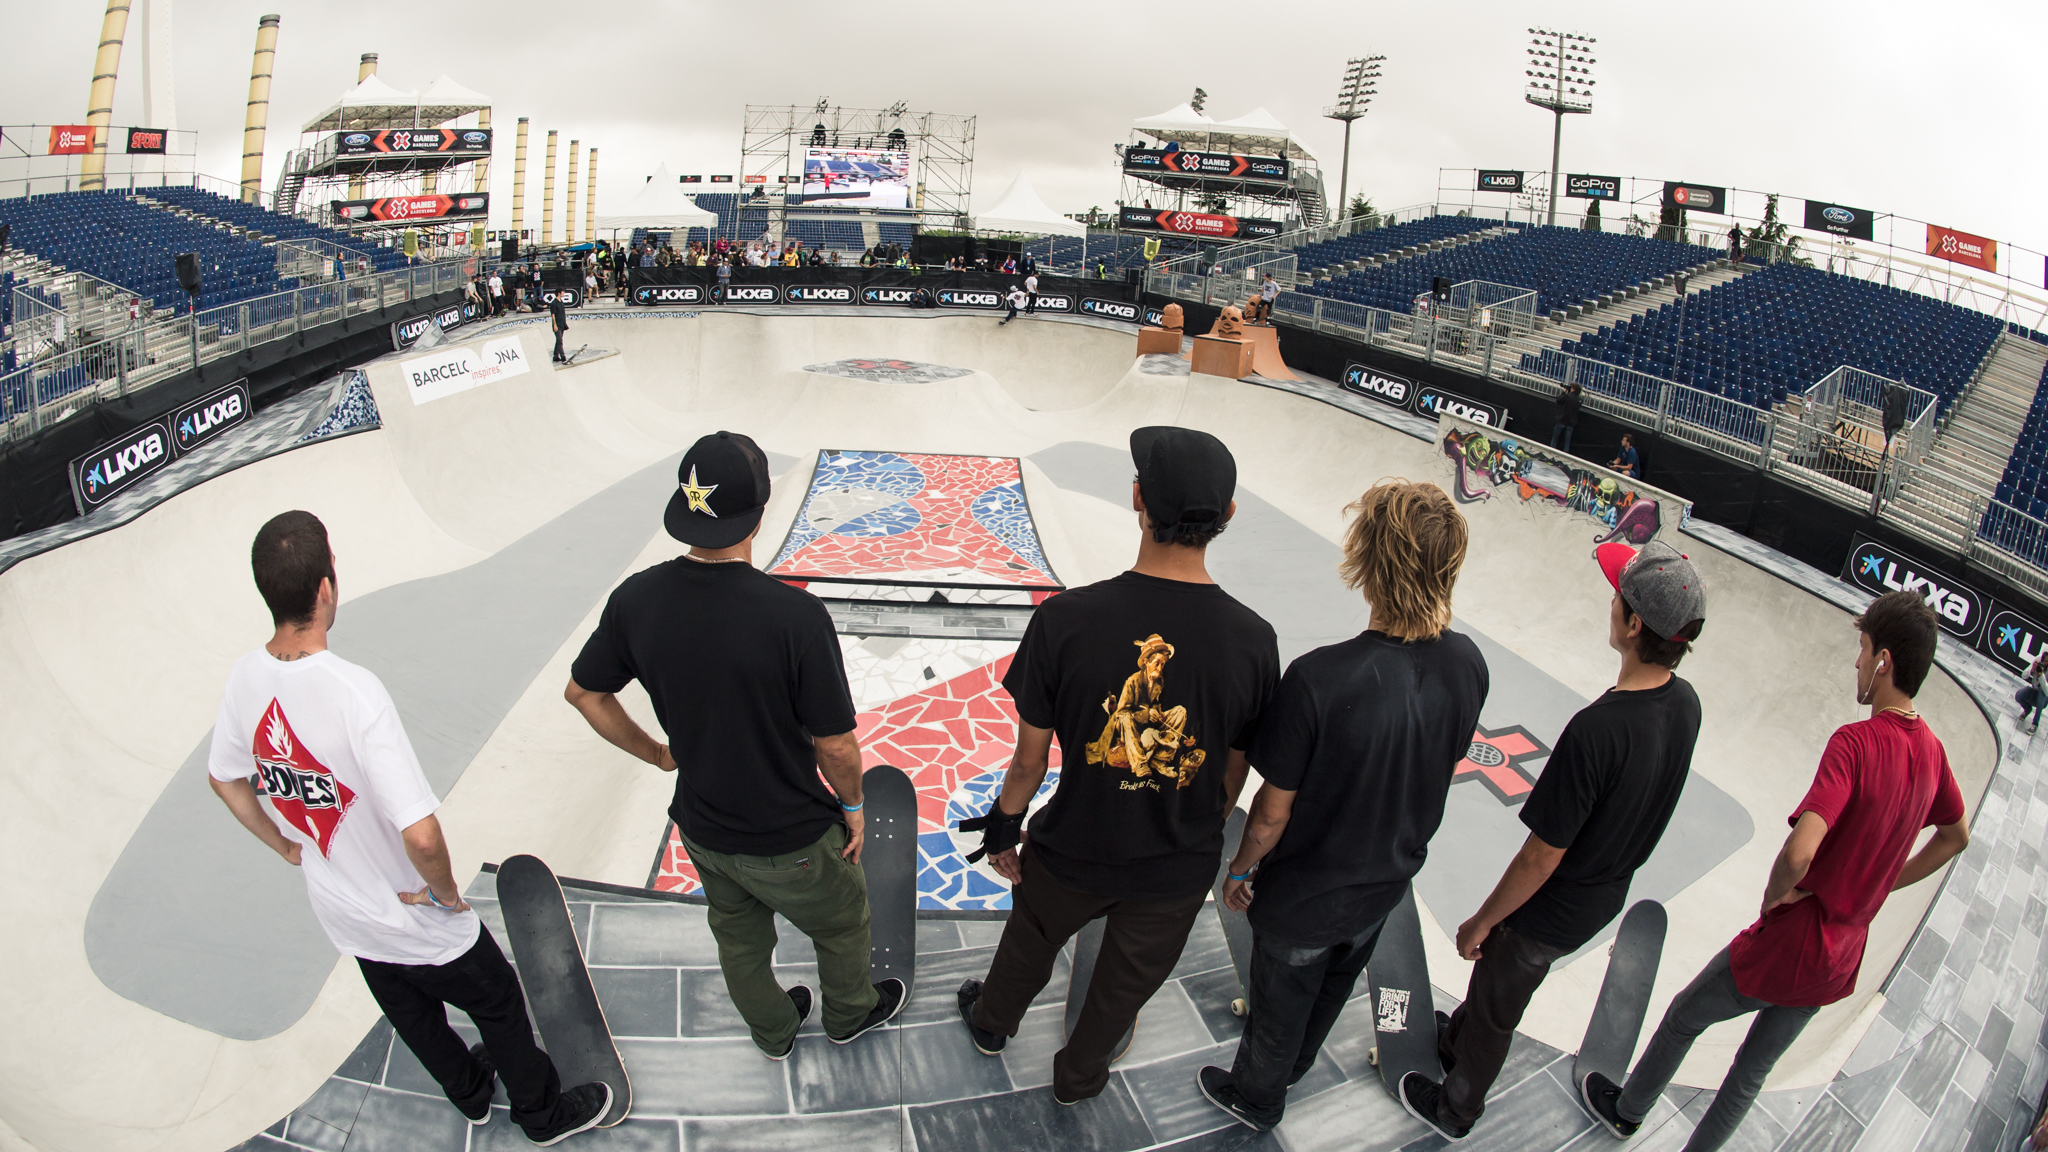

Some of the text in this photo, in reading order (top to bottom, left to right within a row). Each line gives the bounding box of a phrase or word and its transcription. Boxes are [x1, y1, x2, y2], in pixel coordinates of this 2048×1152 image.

[131, 132, 162, 148] SPORT
[1202, 158, 1230, 167] GAMES
[1252, 162, 1284, 171] GoPro
[1570, 178, 1616, 190] GoPro
[410, 200, 436, 209] GAMES
[1195, 218, 1224, 228] GAMES
[1958, 242, 1982, 254] GAMES
[1958, 250, 1981, 259] BARCELONA
[262, 764, 336, 805] BONES
[1381, 991, 1406, 1003] GRIND
[1380, 1000, 1394, 1009] FOR
[1378, 1004, 1394, 1017] LIFE
